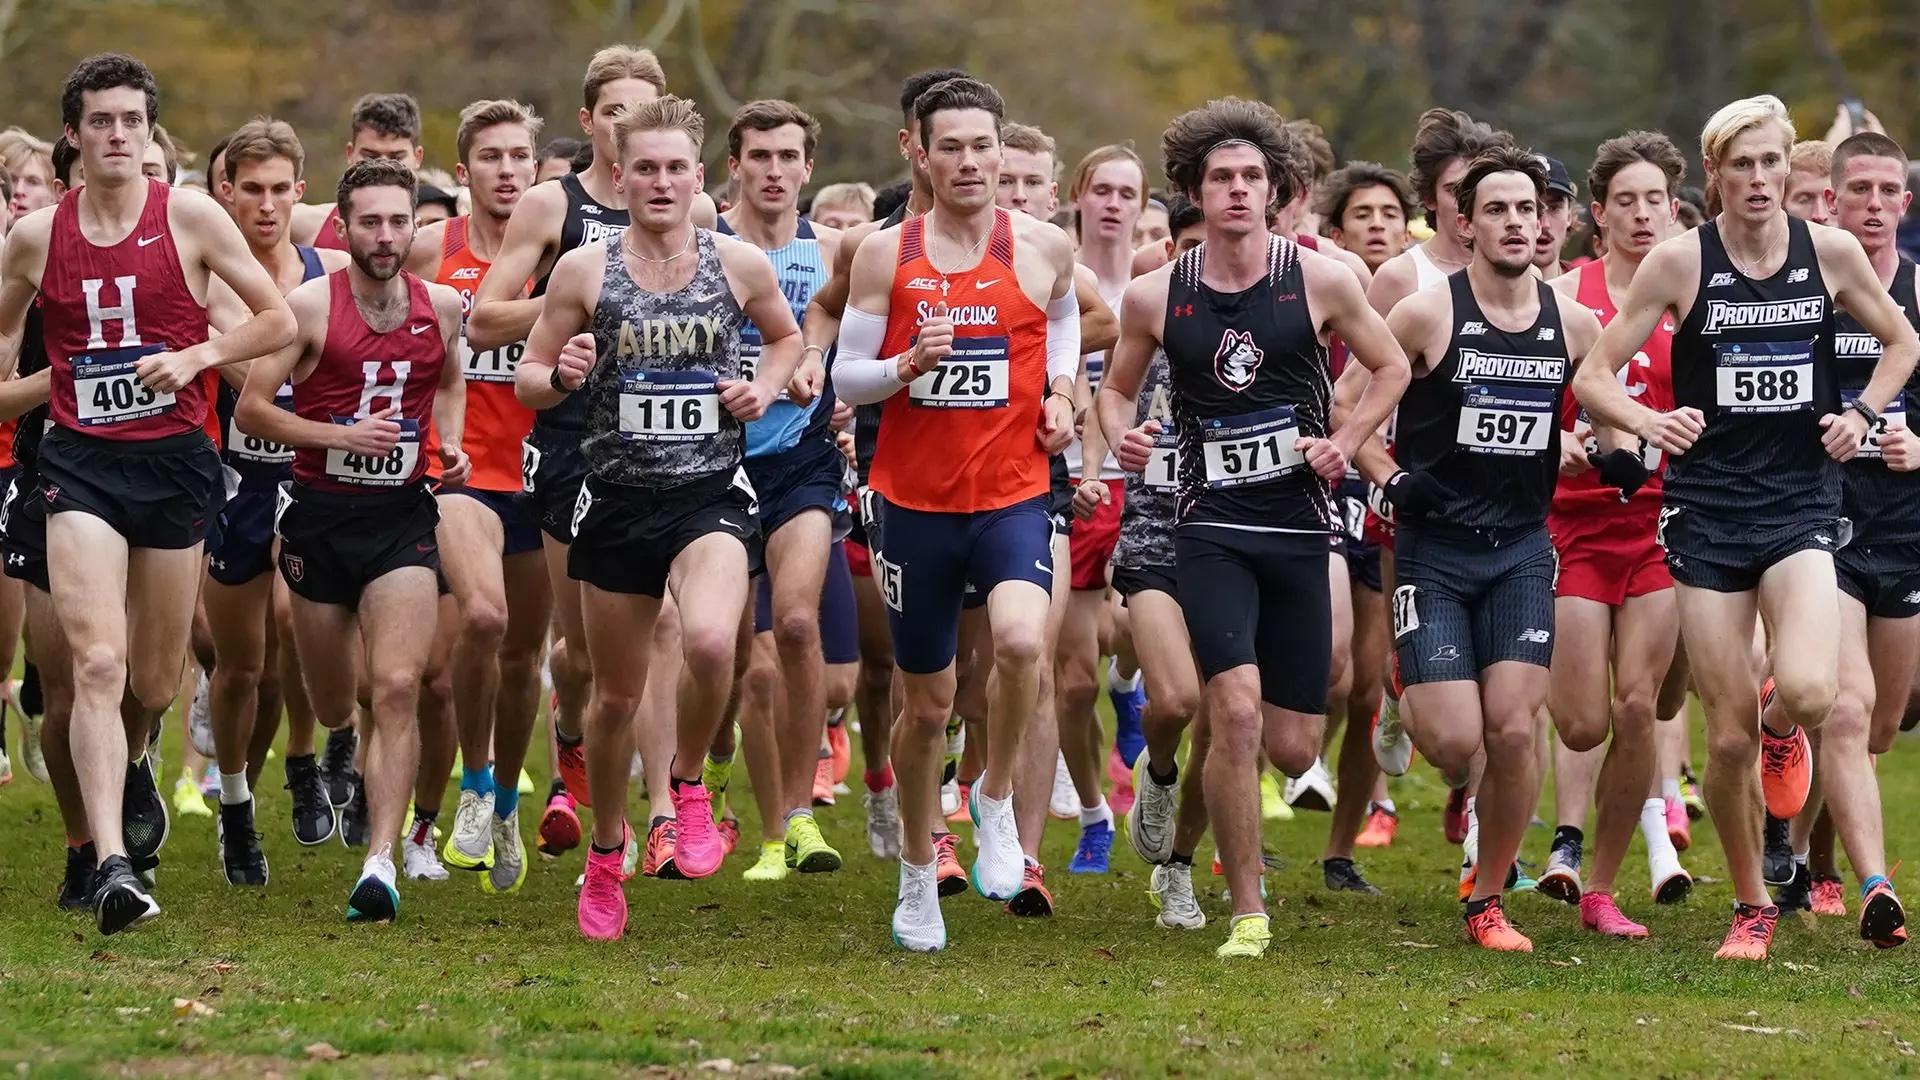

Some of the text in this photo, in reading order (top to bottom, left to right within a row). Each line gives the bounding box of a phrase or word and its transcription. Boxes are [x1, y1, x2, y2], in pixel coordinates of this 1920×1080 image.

[449, 268, 480, 279] ACC
[905, 278, 939, 290] ACC
[82, 275, 142, 350] H
[916, 301, 997, 326] Sacuse
[617, 316, 721, 357] ARMY
[930, 365, 991, 396] 725
[1616, 351, 1651, 397] C
[1735, 370, 1798, 401] 588
[93, 377, 156, 411] 403
[354, 361, 411, 420] H
[638, 399, 702, 430] 116
[1476, 413, 1537, 445] 597
[343, 446, 404, 475] 408
[1221, 435, 1281, 474] 571
